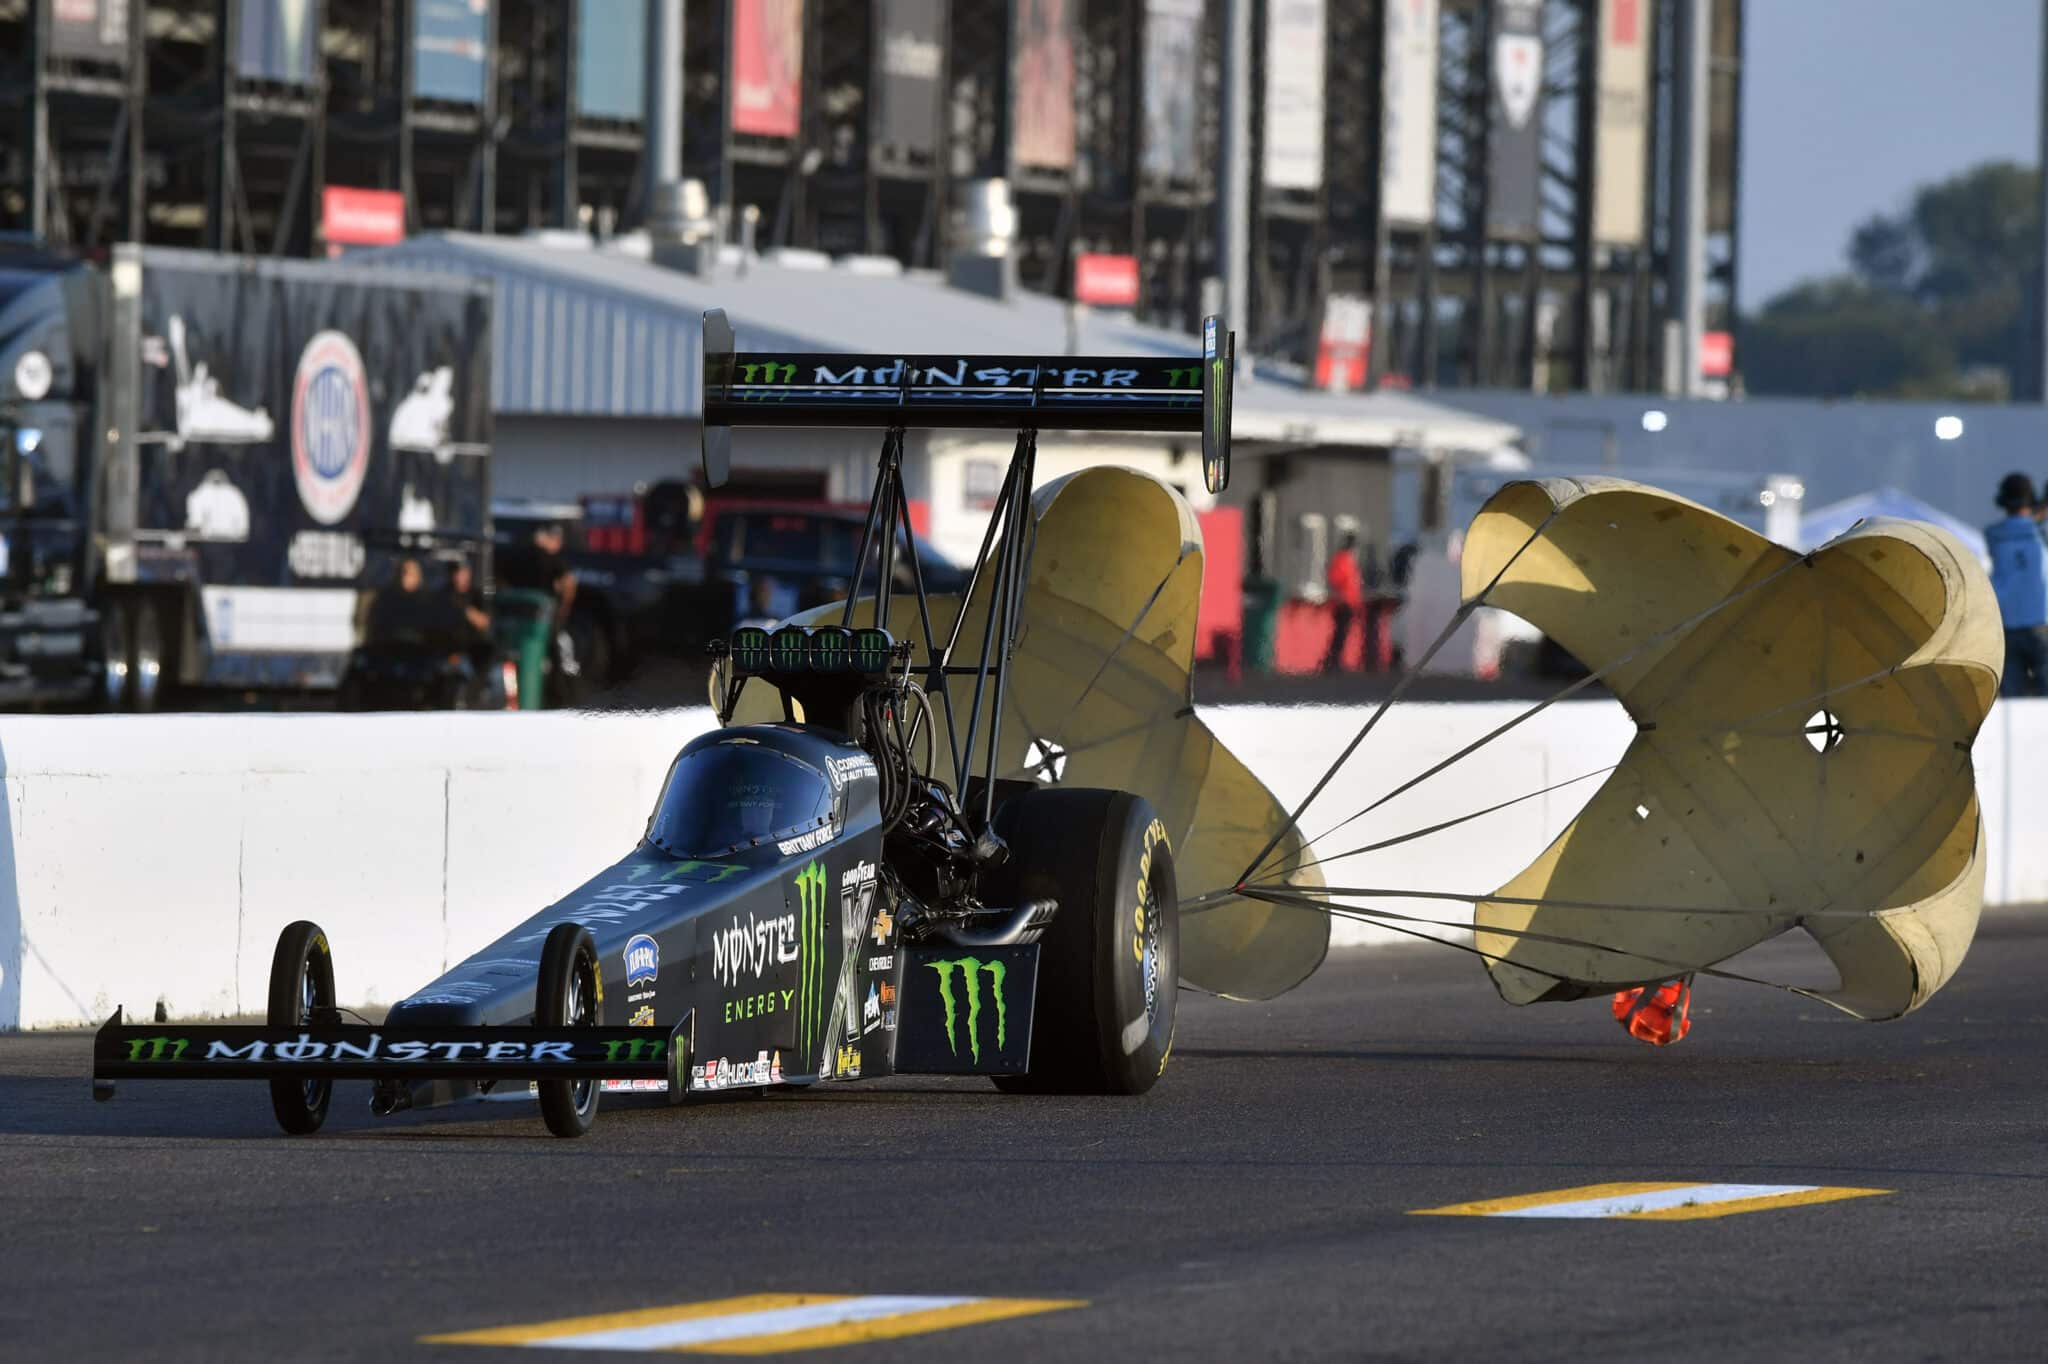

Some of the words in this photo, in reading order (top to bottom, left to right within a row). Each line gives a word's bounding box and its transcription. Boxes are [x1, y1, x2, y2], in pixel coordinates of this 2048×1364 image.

[813, 359, 1141, 389] MONSTER
[777, 830, 818, 857] BRITTANY
[842, 860, 876, 888] GOODYEAR
[712, 911, 799, 988] MONSTER
[725, 989, 795, 1024] ENERGY
[203, 1033, 576, 1063] MONSTER
[727, 1060, 756, 1085] HURCO
